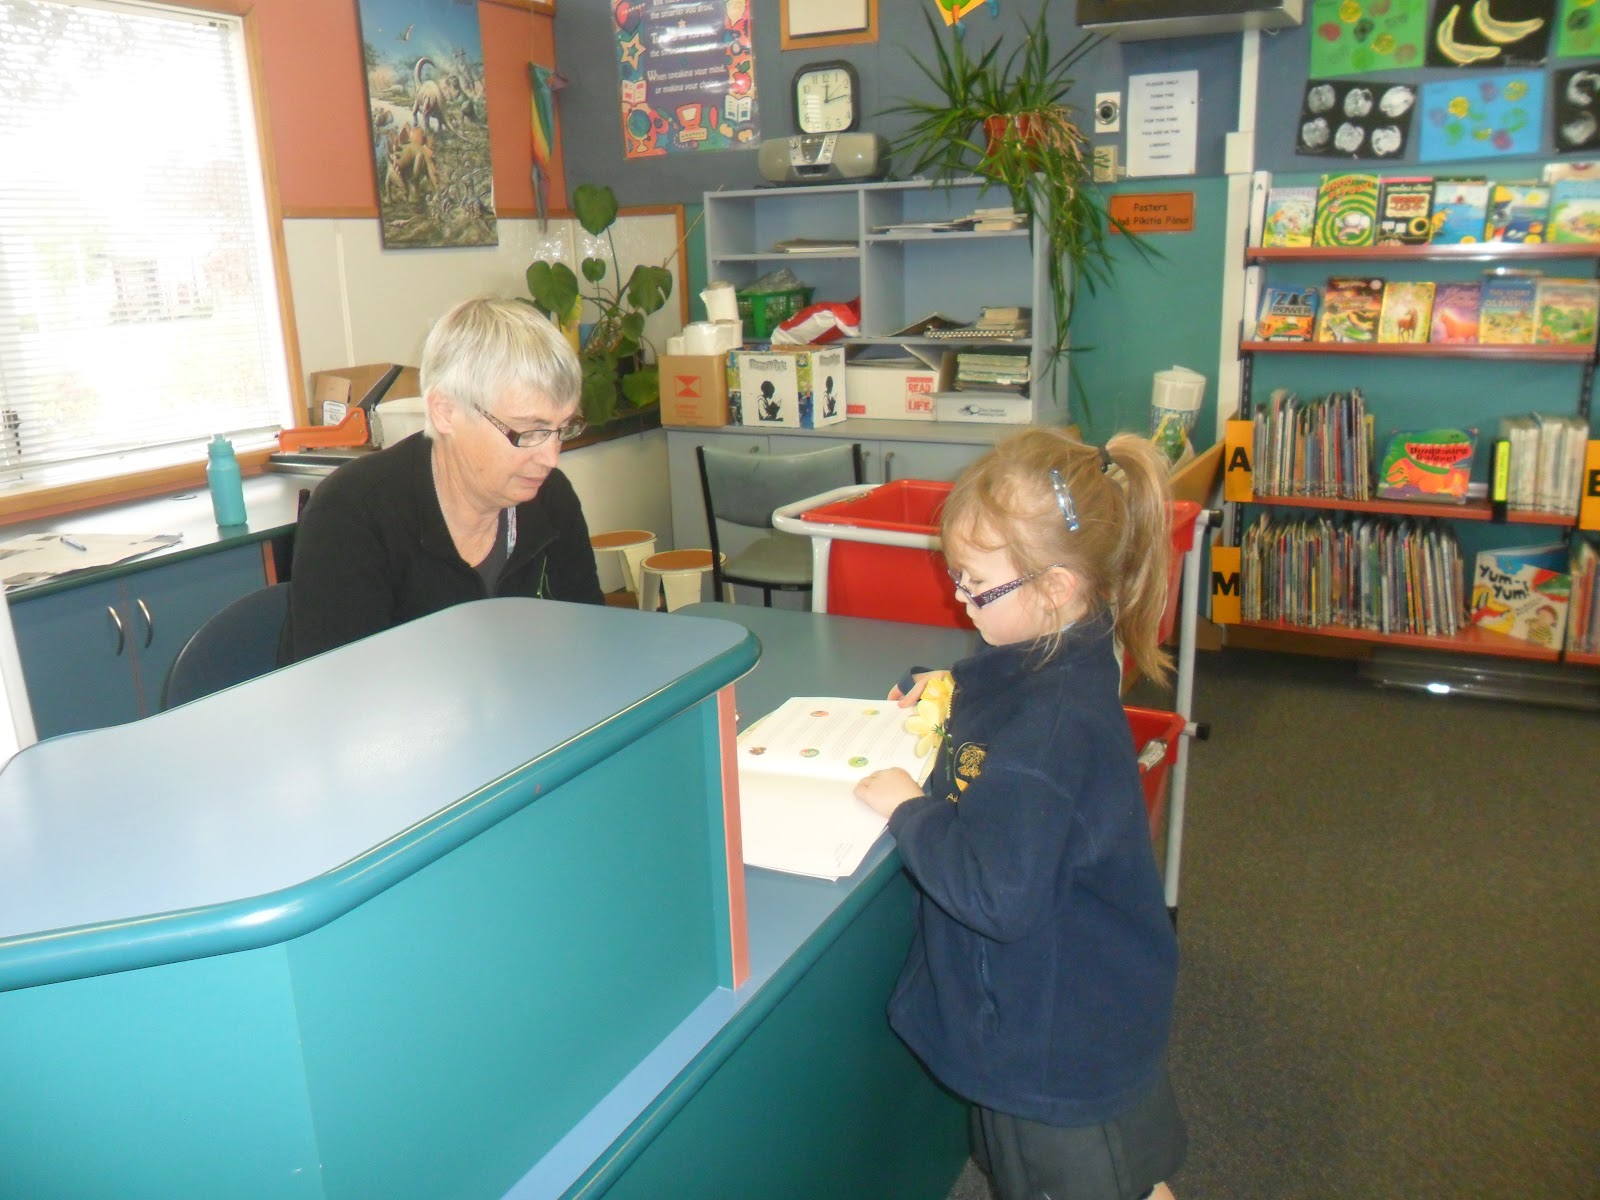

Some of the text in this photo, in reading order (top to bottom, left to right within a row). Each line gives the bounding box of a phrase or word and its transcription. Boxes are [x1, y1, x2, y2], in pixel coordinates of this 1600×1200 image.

[650, 11, 660, 19] the
[661, 8, 684, 18] smarter
[685, 6, 697, 15] you
[647, 69, 668, 82] When
[668, 69, 693, 80] speaking
[694, 68, 708, 77] your
[662, 84, 684, 93] making
[684, 82, 699, 91] your
[1133, 203, 1168, 212] Posters
[1133, 216, 1162, 225] Pikitia
[1273, 291, 1313, 306] ZAC
[1272, 305, 1311, 314] POWER
[908, 383, 931, 394] READ
[908, 400, 931, 411] LIFE
[1228, 446, 1252, 472] A
[1212, 571, 1240, 596] M
